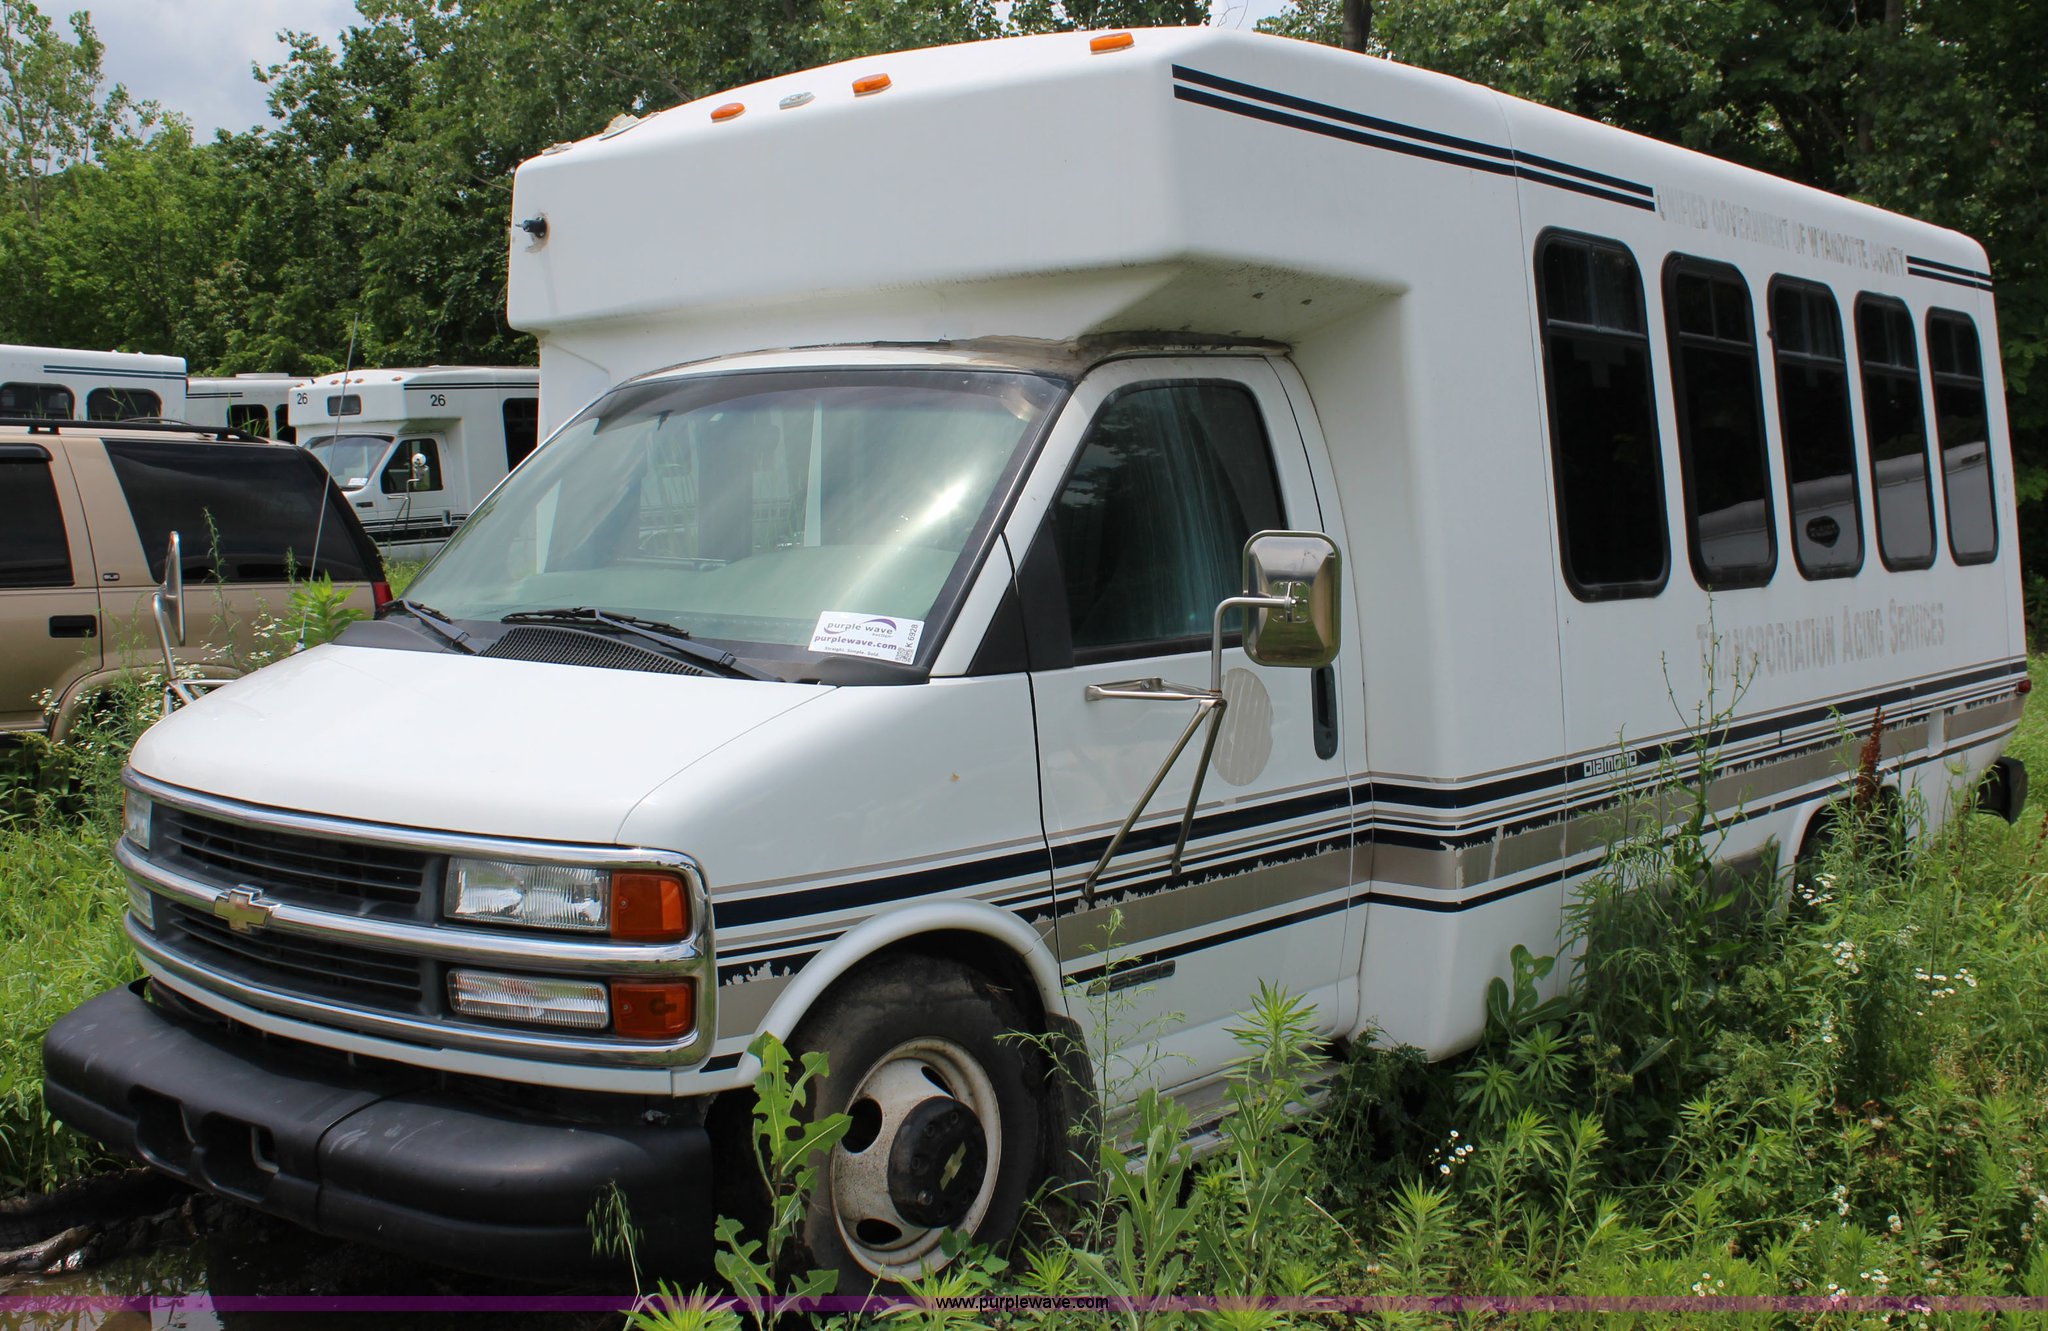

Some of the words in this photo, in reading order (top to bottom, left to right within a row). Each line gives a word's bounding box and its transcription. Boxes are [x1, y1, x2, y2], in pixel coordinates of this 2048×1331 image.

[296, 392, 308, 405] 26
[430, 394, 446, 407] 26
[827, 621, 861, 632] purple
[865, 625, 893, 635] wave
[814, 635, 897, 651] purplewave.com
